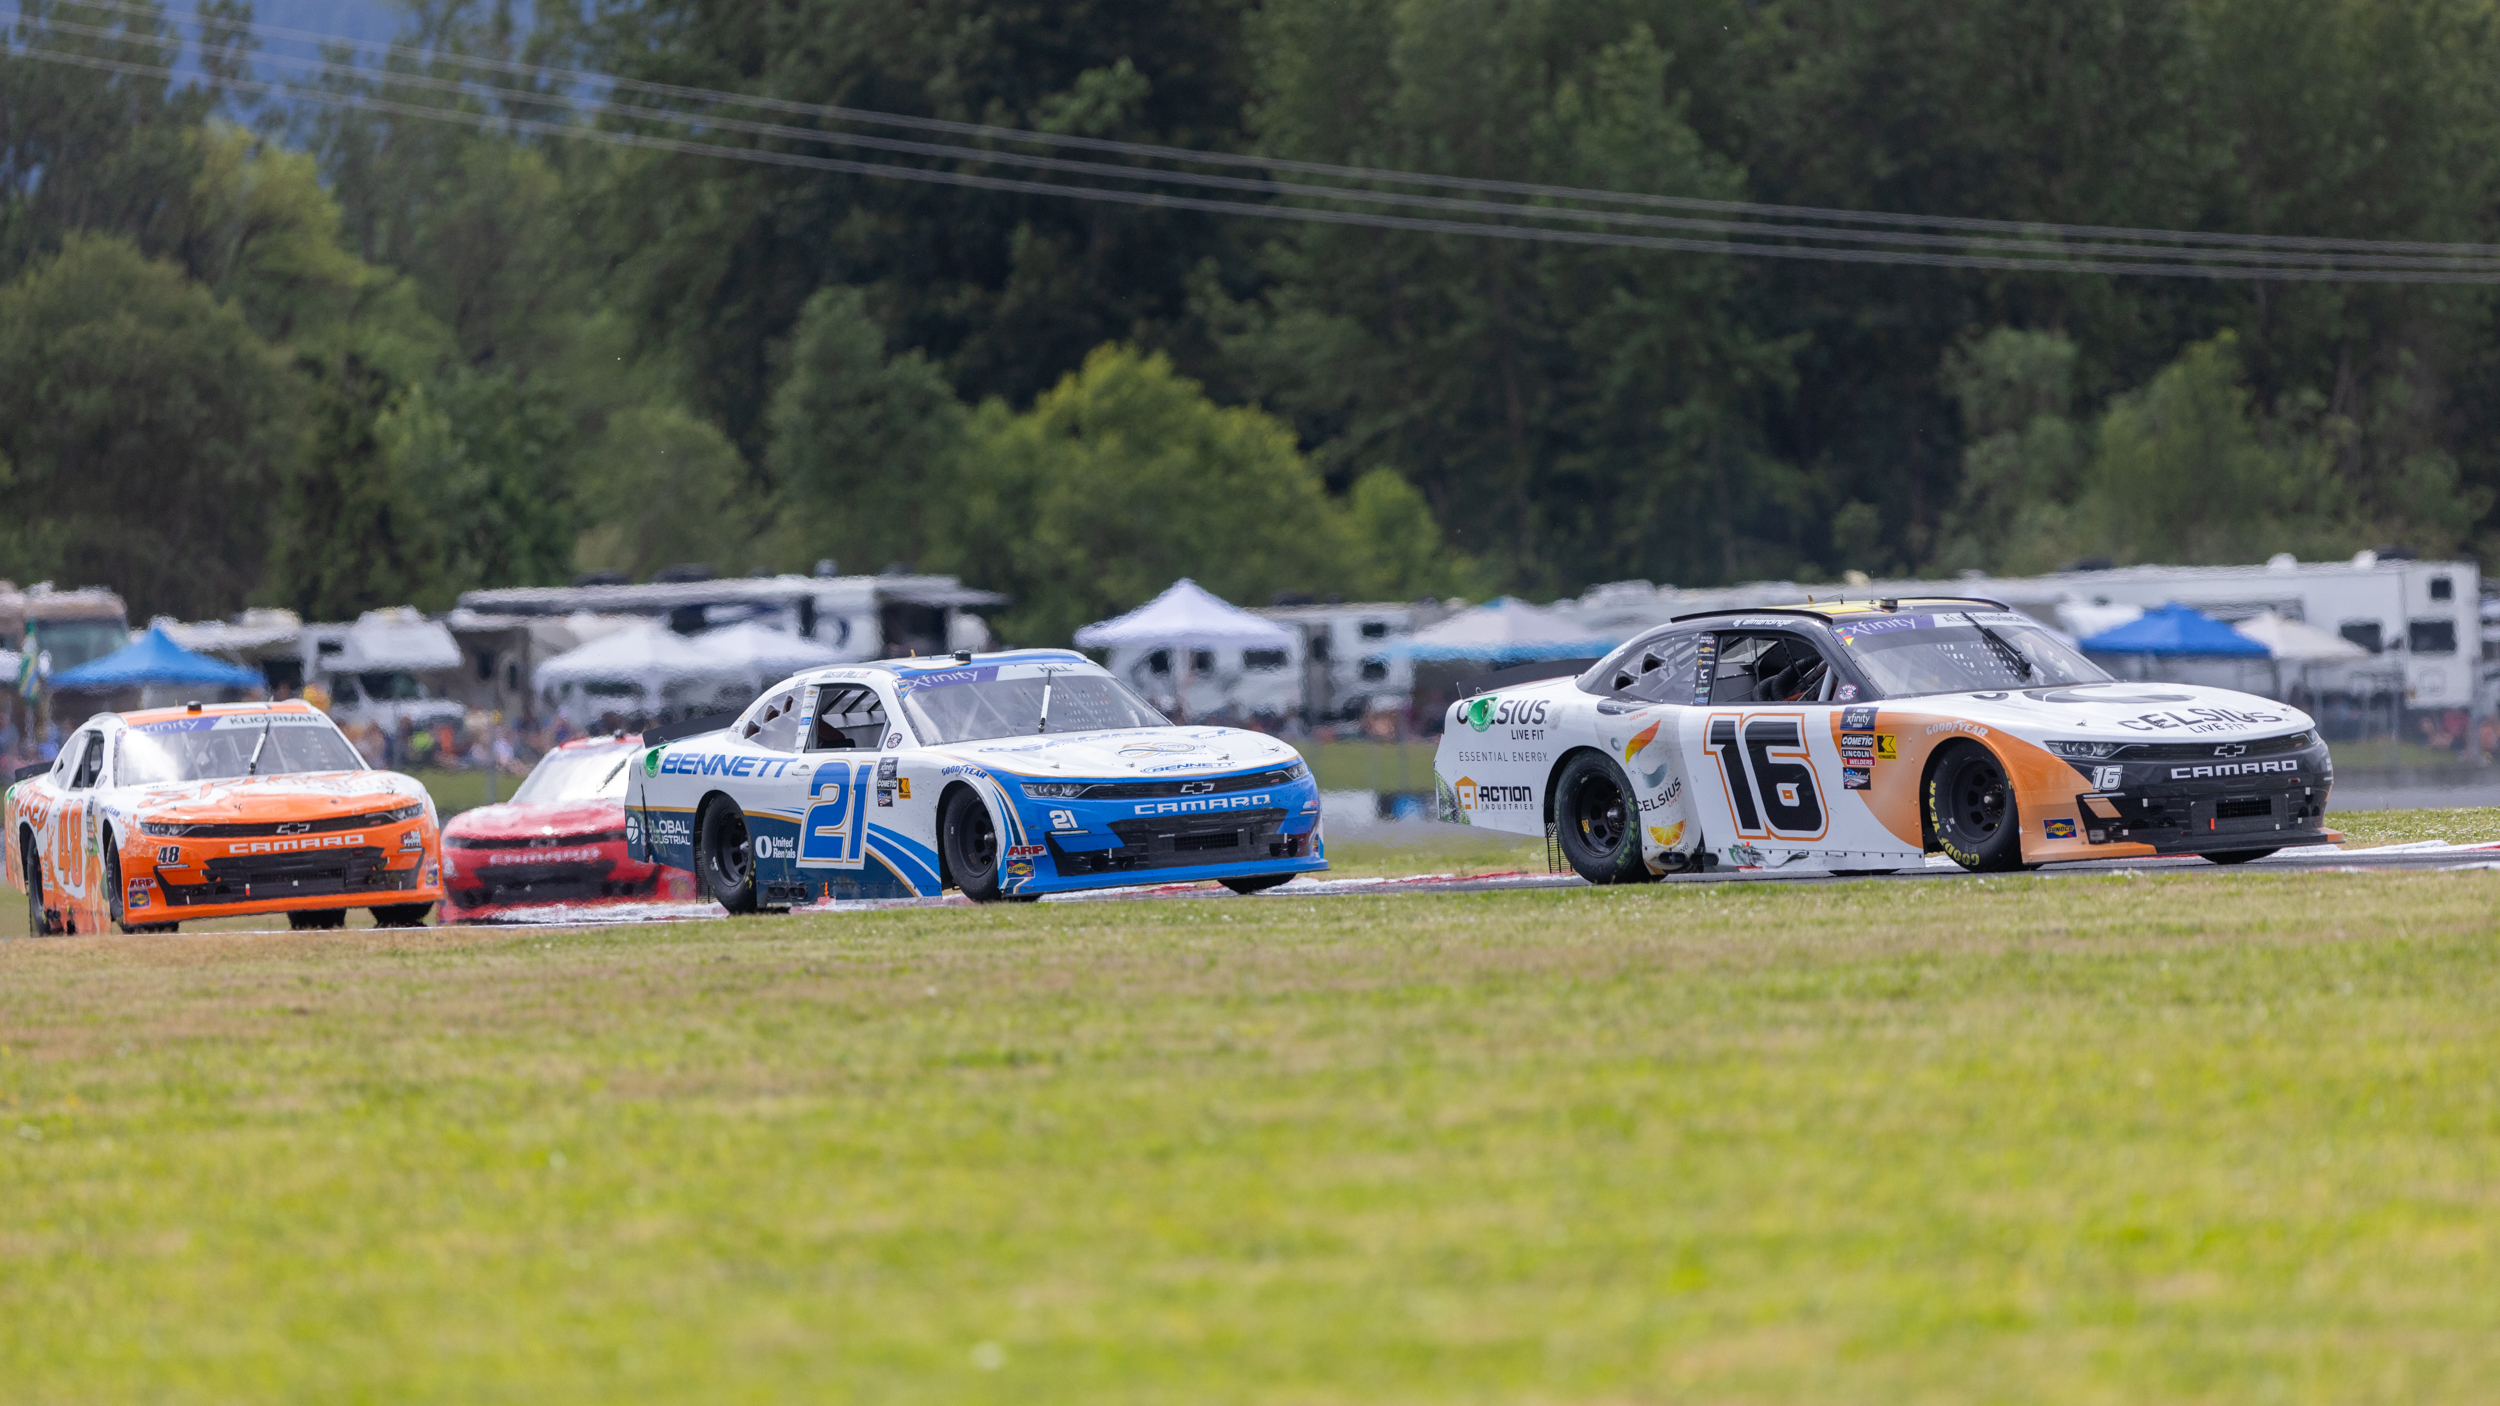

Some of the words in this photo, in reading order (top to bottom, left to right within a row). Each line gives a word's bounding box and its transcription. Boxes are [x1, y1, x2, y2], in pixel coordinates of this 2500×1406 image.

[1846, 617, 1916, 635] xfinity
[908, 670, 979, 692] xfinity
[229, 715, 319, 726] KLIGERMAN
[1457, 699, 1551, 725] CSIUS
[1847, 713, 1870, 726] xfinity
[2117, 708, 2284, 731] CELSIUS
[137, 717, 199, 736] finity
[1511, 729, 1530, 740] LIVE
[1532, 729, 1545, 740] FIT
[2188, 723, 2226, 734] LIVE
[2226, 721, 2249, 731] FIT
[1842, 736, 1873, 746] COMETIC
[1459, 752, 1508, 761] ESSENTIAL
[1842, 750, 1870, 758] LINCOLN
[660, 752, 799, 778] BENNETT
[2170, 760, 2298, 779] CAMARO
[1705, 713, 1828, 841] 16
[2092, 764, 2123, 790] 16
[1479, 786, 1533, 802] ACTION
[1637, 777, 1682, 812] CELSIUS
[801, 759, 877, 863] 21
[1134, 794, 1271, 815] CAMARO
[1049, 809, 1079, 829] 21
[2046, 825, 2075, 833] SUNOCO
[58, 798, 83, 887] 48
[229, 834, 364, 853] CAMARO
[772, 836, 794, 848] United
[1007, 845, 1046, 857] ARP
[156, 844, 180, 865] 48
[772, 847, 796, 859] Rentals
[1008, 864, 1034, 874] SUNOCO
[130, 878, 155, 888] ARP
